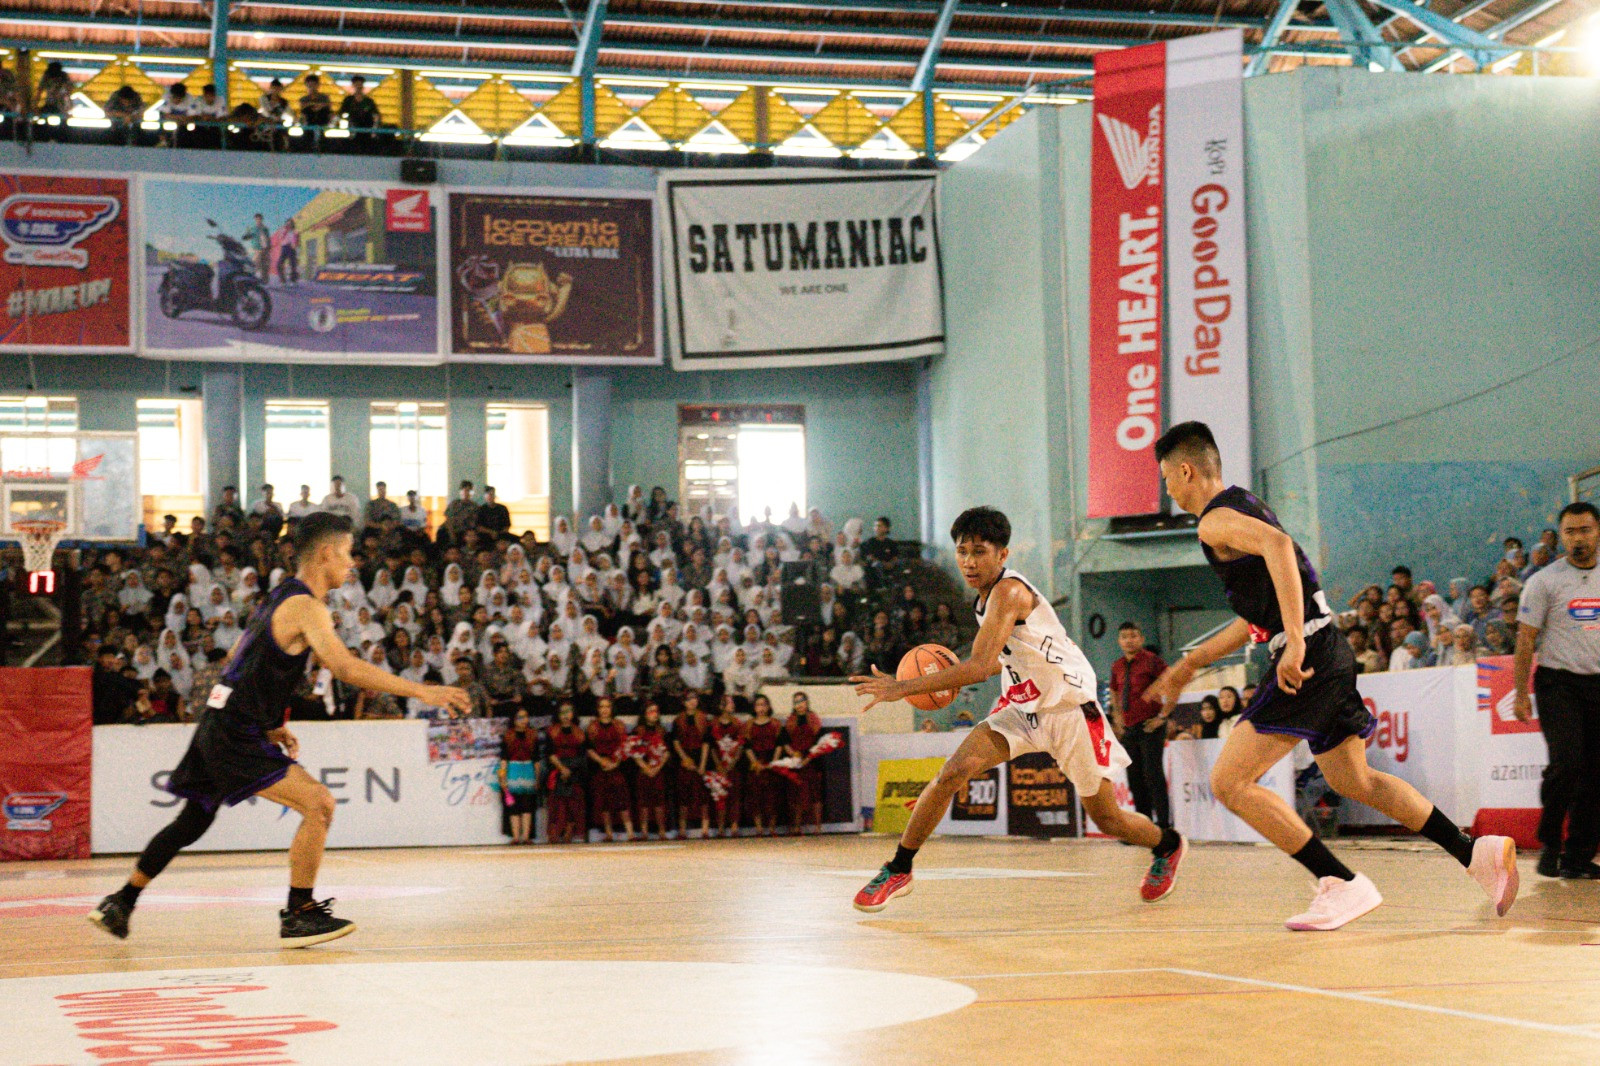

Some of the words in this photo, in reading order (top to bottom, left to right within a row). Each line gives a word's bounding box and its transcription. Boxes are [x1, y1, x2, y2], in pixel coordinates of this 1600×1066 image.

[1147, 103, 1162, 186] HONDA
[483, 233, 525, 246] ICE
[529, 234, 620, 249] CREAM
[688, 214, 928, 274] SATUMANIAC
[1117, 204, 1160, 355] HEART.
[1184, 183, 1232, 377] GoodDay
[779, 285, 796, 295] WE
[800, 284, 822, 295] ARE
[825, 283, 848, 293] ONE
[1115, 363, 1157, 452] One
